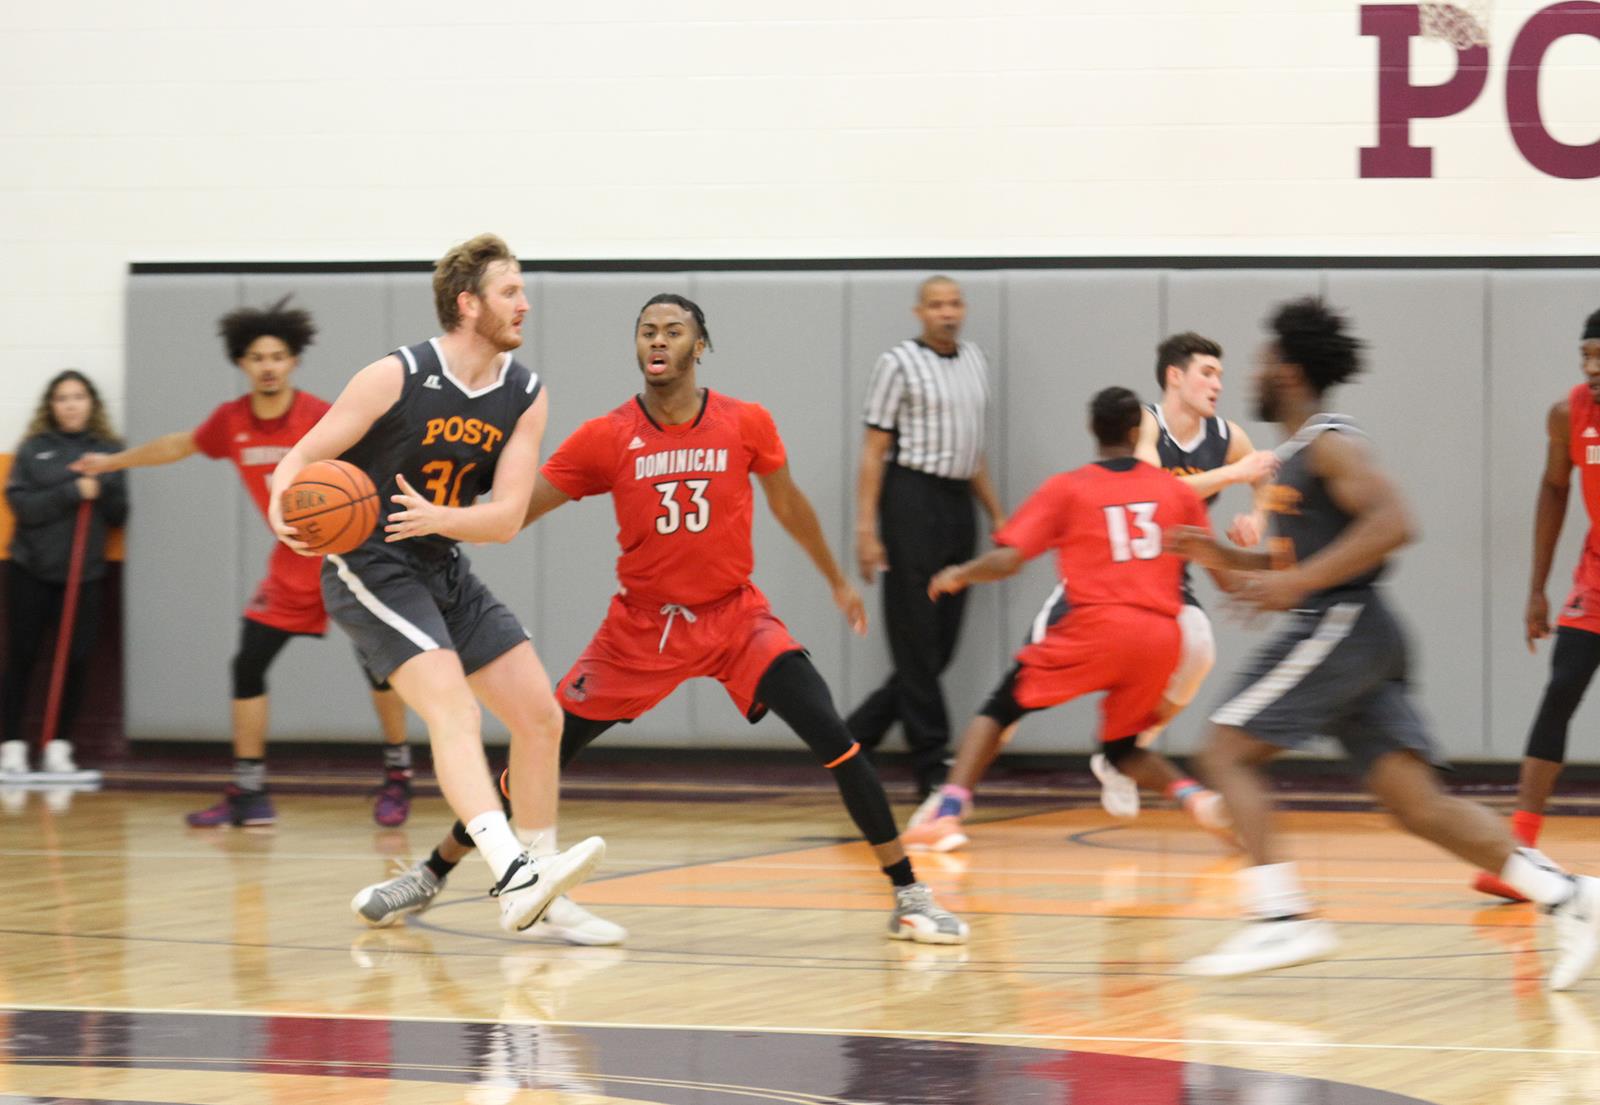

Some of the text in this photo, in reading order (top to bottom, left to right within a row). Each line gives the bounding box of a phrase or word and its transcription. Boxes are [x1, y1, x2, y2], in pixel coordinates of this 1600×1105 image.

[421, 415, 504, 453] POST
[634, 448, 729, 481] DOMINICAN
[652, 478, 712, 535] 33
[1101, 501, 1163, 563] 13
